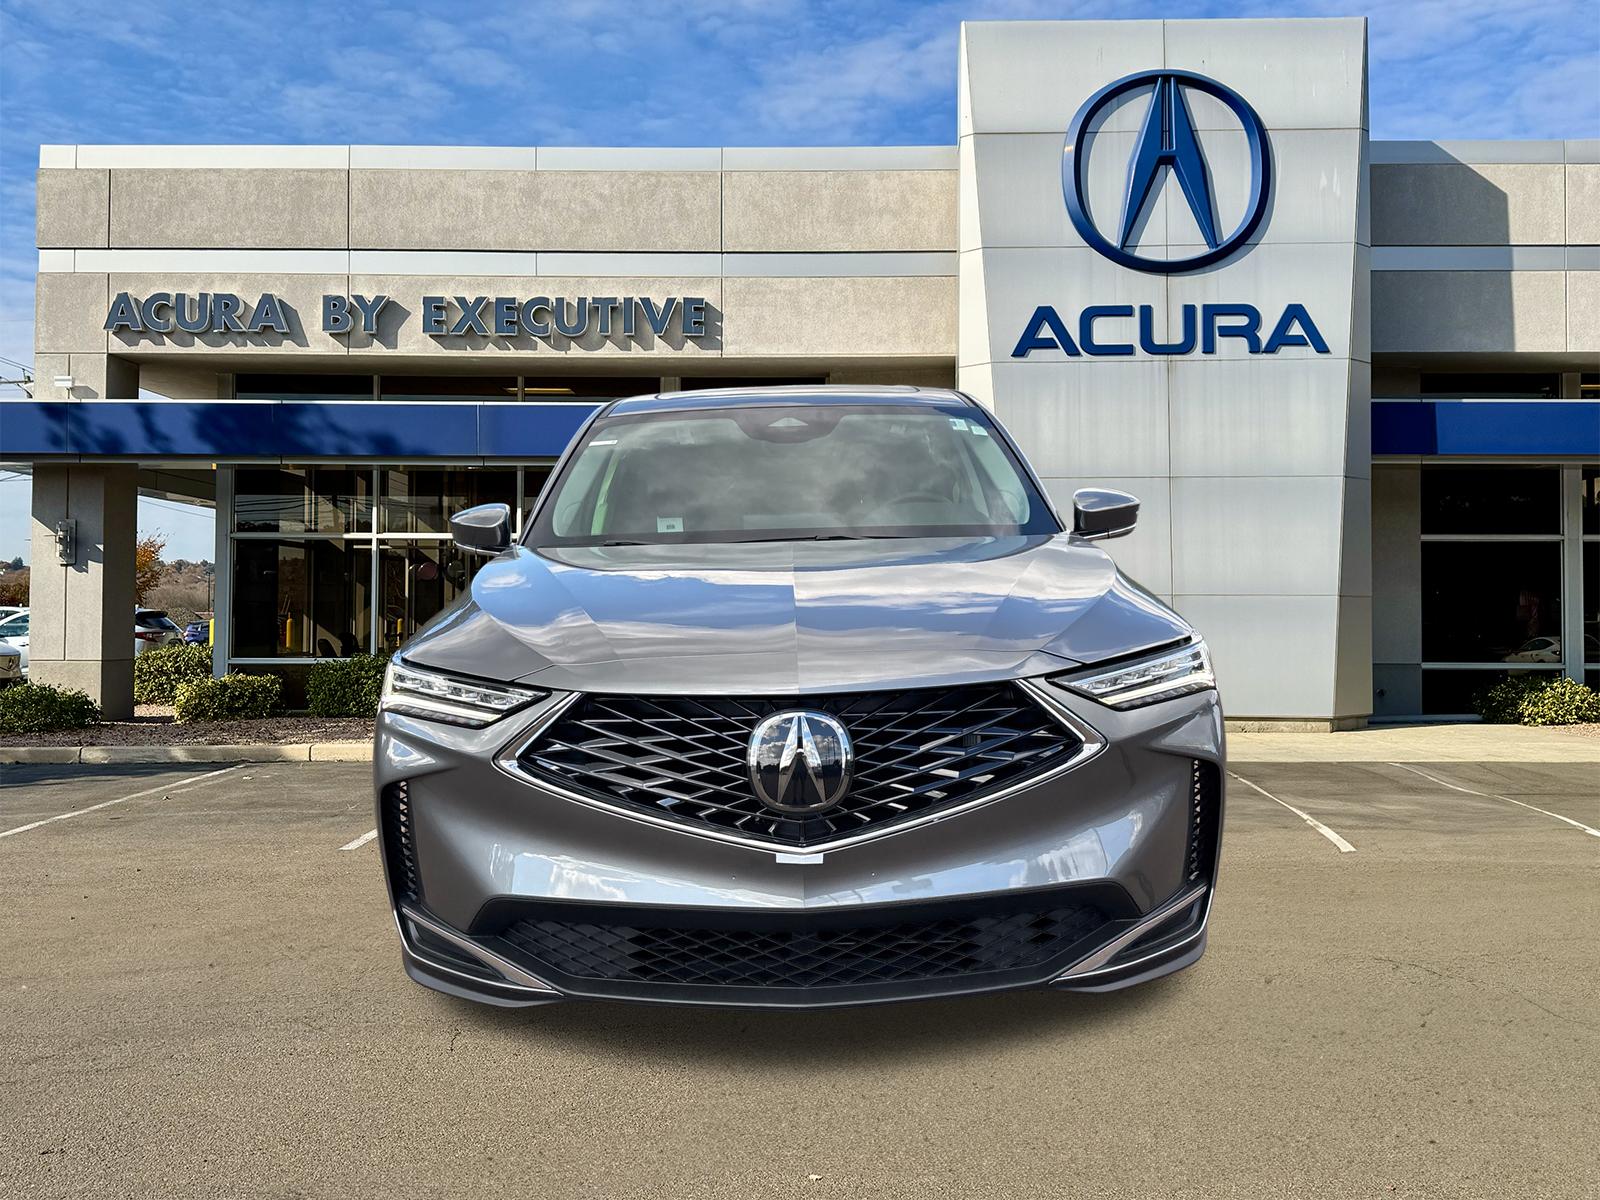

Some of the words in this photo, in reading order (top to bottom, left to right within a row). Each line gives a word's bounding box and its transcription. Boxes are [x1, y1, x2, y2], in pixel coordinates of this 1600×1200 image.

[103, 292, 289, 333] ACURA
[322, 294, 391, 334] BY
[422, 296, 706, 337] EXECUTIVE
[1011, 303, 1332, 357] ACURA
